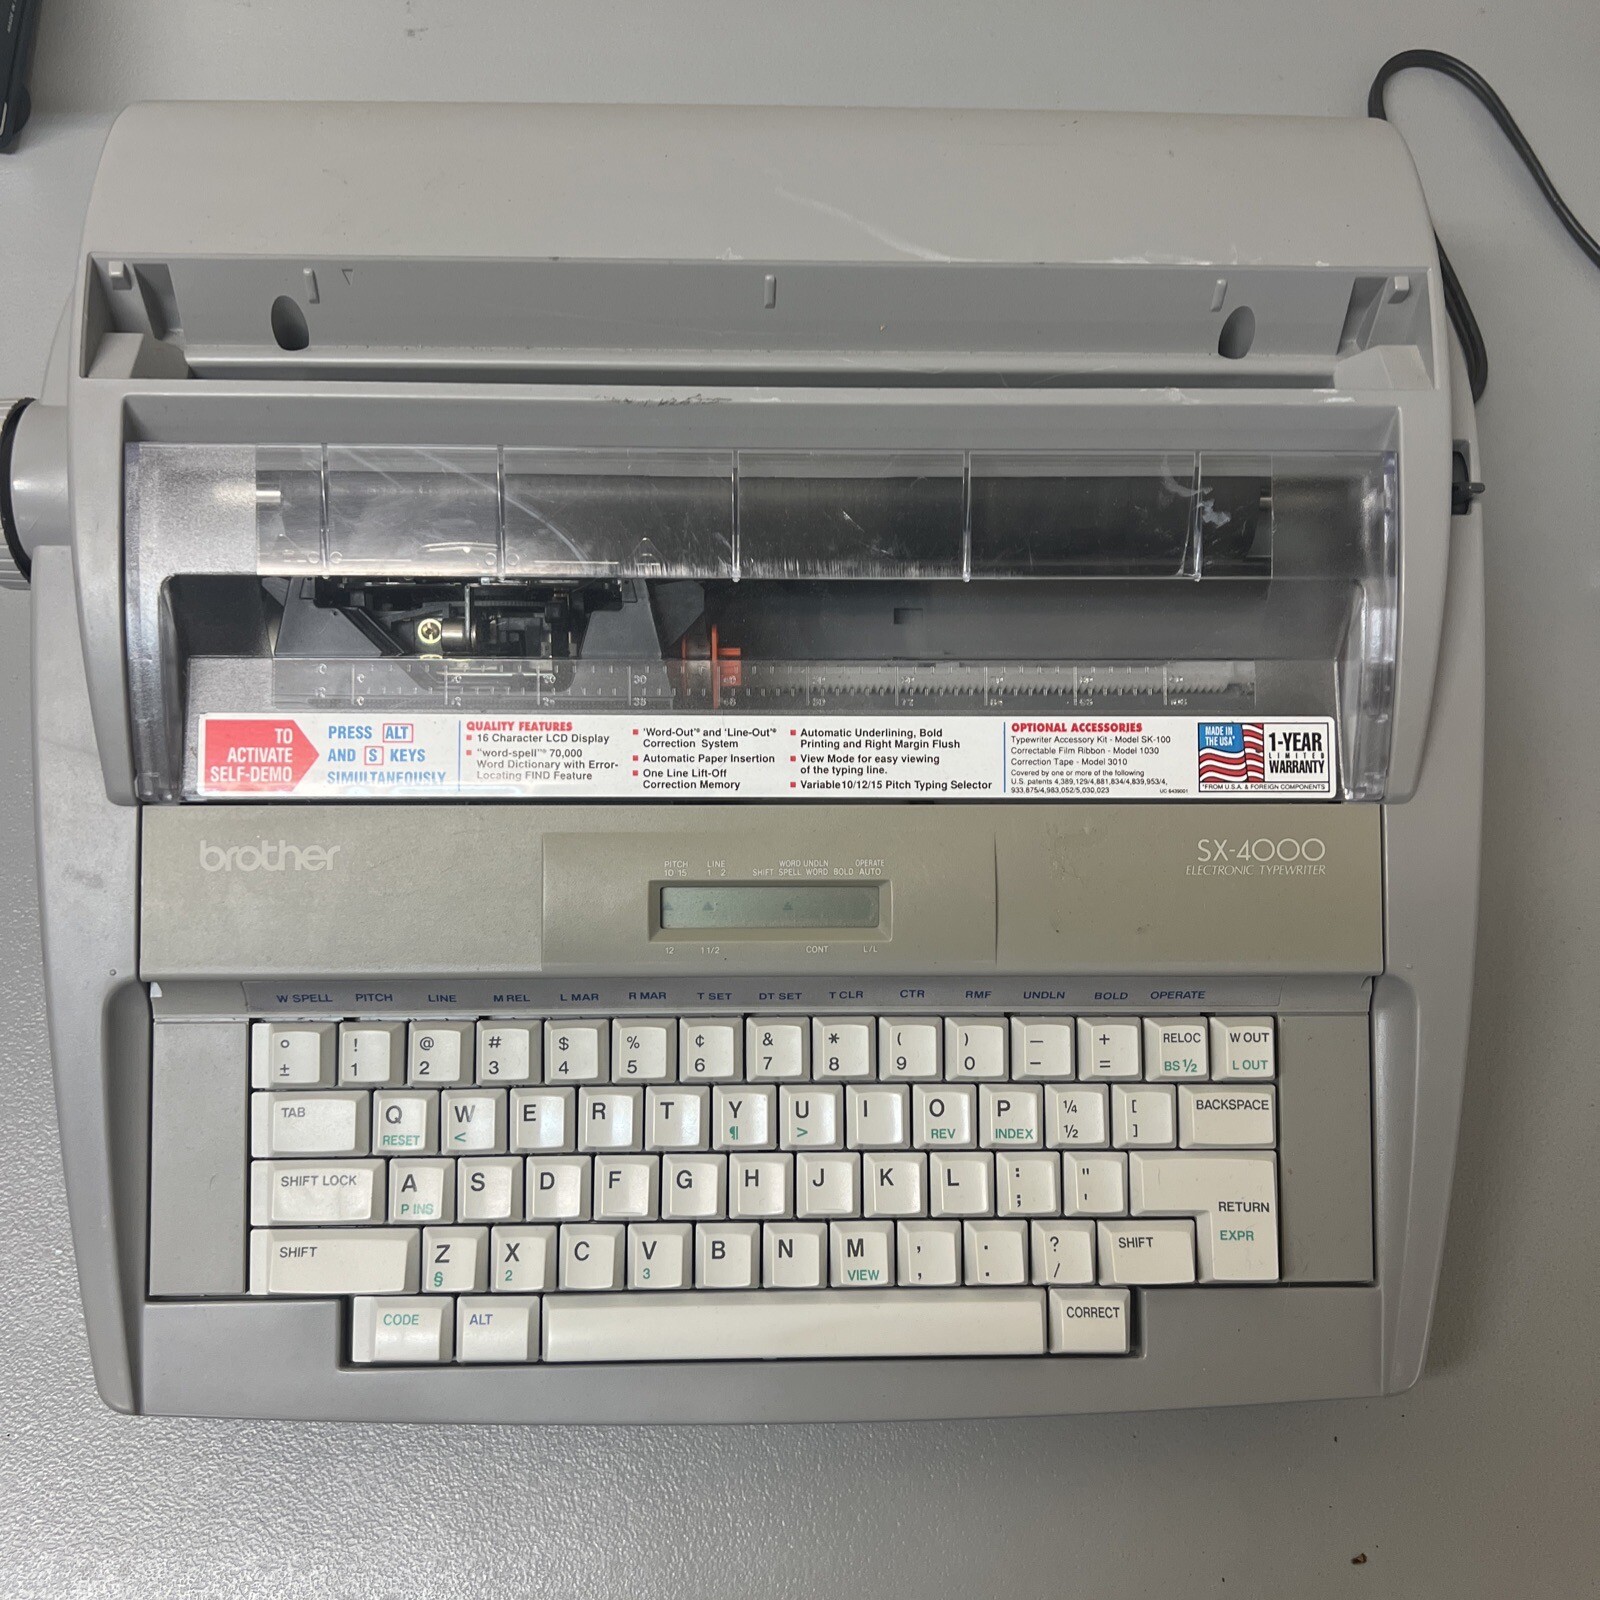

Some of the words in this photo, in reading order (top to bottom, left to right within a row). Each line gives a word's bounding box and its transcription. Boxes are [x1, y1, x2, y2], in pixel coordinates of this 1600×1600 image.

[328, 726, 373, 739] PRESS
[385, 725, 409, 739] ALT
[466, 721, 515, 731] QUALITY
[518, 721, 573, 732] FEATURES
[1011, 722, 1067, 733] OPTIONAL
[1071, 722, 1143, 733] ACCESSORIES
[1205, 726, 1224, 735] MADE
[1225, 726, 1233, 735] IN
[274, 728, 293, 744] TO
[702, 728, 722, 737] and
[800, 728, 852, 738] Automatic
[854, 728, 917, 739] Underlining,
[919, 728, 943, 738] Bold
[477, 734, 489, 742] 16
[491, 734, 542, 743] Character
[546, 734, 568, 743] LCD
[571, 734, 610, 745] Display
[643, 739, 696, 748] Correction
[701, 739, 739, 750] System
[800, 740, 840, 750] Printing
[842, 740, 862, 749] and
[864, 739, 892, 750] Right
[894, 740, 930, 750] Margin
[932, 740, 961, 749] Flush
[1010, 736, 1052, 745] Typewriter
[1053, 736, 1095, 745] Accessory
[1141, 736, 1171, 744] SK-100
[1205, 736, 1218, 746] THE
[1268, 732, 1322, 751] 1-YEAR
[227, 748, 293, 763] ACTIVATE
[327, 749, 356, 762] AND
[368, 749, 378, 762] S
[390, 749, 426, 762] KEYS
[549, 749, 583, 759] 70,000
[1010, 747, 1056, 755] Correctable
[1058, 747, 1075, 755] Film
[1077, 747, 1105, 755] Ribbon
[1112, 747, 1138, 755] Model
[1140, 747, 1160, 755] 1030
[643, 753, 695, 763] Automatic
[698, 753, 728, 765] Paper
[730, 754, 775, 763] Insertion
[800, 754, 825, 763] View
[827, 754, 855, 763] Mode
[857, 754, 872, 763] for
[874, 756, 898, 765] easy
[901, 755, 940, 765] viewing
[1010, 758, 1052, 766] Correction
[1054, 758, 1074, 768] Tape
[1081, 758, 1106, 766] Model
[1107, 758, 1128, 766] 3010
[476, 759, 505, 769] Word
[507, 760, 561, 771] Dictionary
[564, 760, 585, 769] with
[588, 760, 619, 769] Error-
[1269, 760, 1325, 774] WARRANTY
[210, 766, 293, 783] SELF-DEMO
[477, 771, 522, 781] Locating
[525, 771, 551, 780] FIND
[553, 771, 593, 780] Feature
[643, 769, 664, 778] One
[667, 769, 689, 778] Line
[691, 768, 727, 778] Lift-Off
[800, 766, 811, 774] of
[813, 766, 829, 774] the
[831, 766, 864, 776] typing
[866, 766, 888, 774] line.
[1040, 770, 1049, 778] by
[1114, 770, 1145, 778] following
[327, 771, 446, 784] SIMULTANEOUSLY
[642, 780, 697, 789] Correction
[699, 780, 740, 791] Memory
[885, 780, 911, 790] Pitch
[914, 780, 948, 791] Typing
[950, 780, 993, 790] Selector
[200, 839, 341, 872] brother
[1197, 838, 1326, 862] SX-4000
[664, 860, 689, 868] PITCH
[707, 860, 726, 868] LINE
[779, 860, 801, 868] WORD
[855, 859, 885, 867] OPERATE
[752, 868, 774, 876] SHIFT
[778, 868, 802, 876] SPELL
[805, 868, 829, 876] WORD
[833, 868, 854, 876] BOLD
[859, 868, 882, 876] AUTO
[1185, 865, 1254, 875] ELECTRONIC
[1260, 865, 1326, 875] TYPEWRITER
[806, 945, 829, 954] CONT
[276, 995, 288, 1003] W
[293, 994, 333, 1003] SPELL
[355, 993, 393, 1002] PITCH
[428, 994, 457, 1003] LINE
[493, 994, 504, 1002] M
[506, 994, 531, 1002] REL
[560, 993, 568, 1002] L
[571, 993, 599, 1001] MAR
[628, 992, 637, 1000] R
[639, 991, 667, 1000] MAR
[697, 992, 705, 1000] T
[708, 992, 733, 1000] SET
[759, 992, 778, 1000] DT
[779, 992, 802, 1000] SET
[829, 991, 837, 999] T
[839, 990, 864, 999] CLR
[900, 989, 925, 998] CTR
[965, 990, 992, 999] RMF
[1023, 991, 1065, 1000] UNDLN
[1094, 991, 1129, 1000] BOLD
[1150, 990, 1205, 1000] OPERATE
[1162, 1033, 1201, 1043] RELOC
[1230, 1033, 1241, 1043] W
[1244, 1032, 1269, 1043] OUT
[1196, 1099, 1269, 1111] BACKSPACE
[281, 1107, 306, 1118] TAB
[385, 1105, 403, 1124] Q
[930, 1129, 956, 1139] REV
[995, 1128, 1033, 1139] INDEX
[383, 1135, 420, 1145] RESET
[281, 1176, 319, 1187] SHIFT
[323, 1175, 357, 1186] LOCK
[676, 1169, 693, 1189] G
[880, 1168, 895, 1186] K
[401, 1174, 418, 1192] A
[400, 1204, 409, 1215] P
[413, 1203, 434, 1215] INS
[1218, 1202, 1270, 1213] RETURN
[1219, 1230, 1254, 1241] EXPR
[1118, 1237, 1154, 1249] SHIFT
[279, 1246, 318, 1258] SHIFT
[434, 1244, 450, 1264] Z
[847, 1269, 880, 1281] VIEW
[1066, 1307, 1120, 1318] CORRECT
[383, 1314, 419, 1326] CODE
[469, 1314, 493, 1326] ALT
